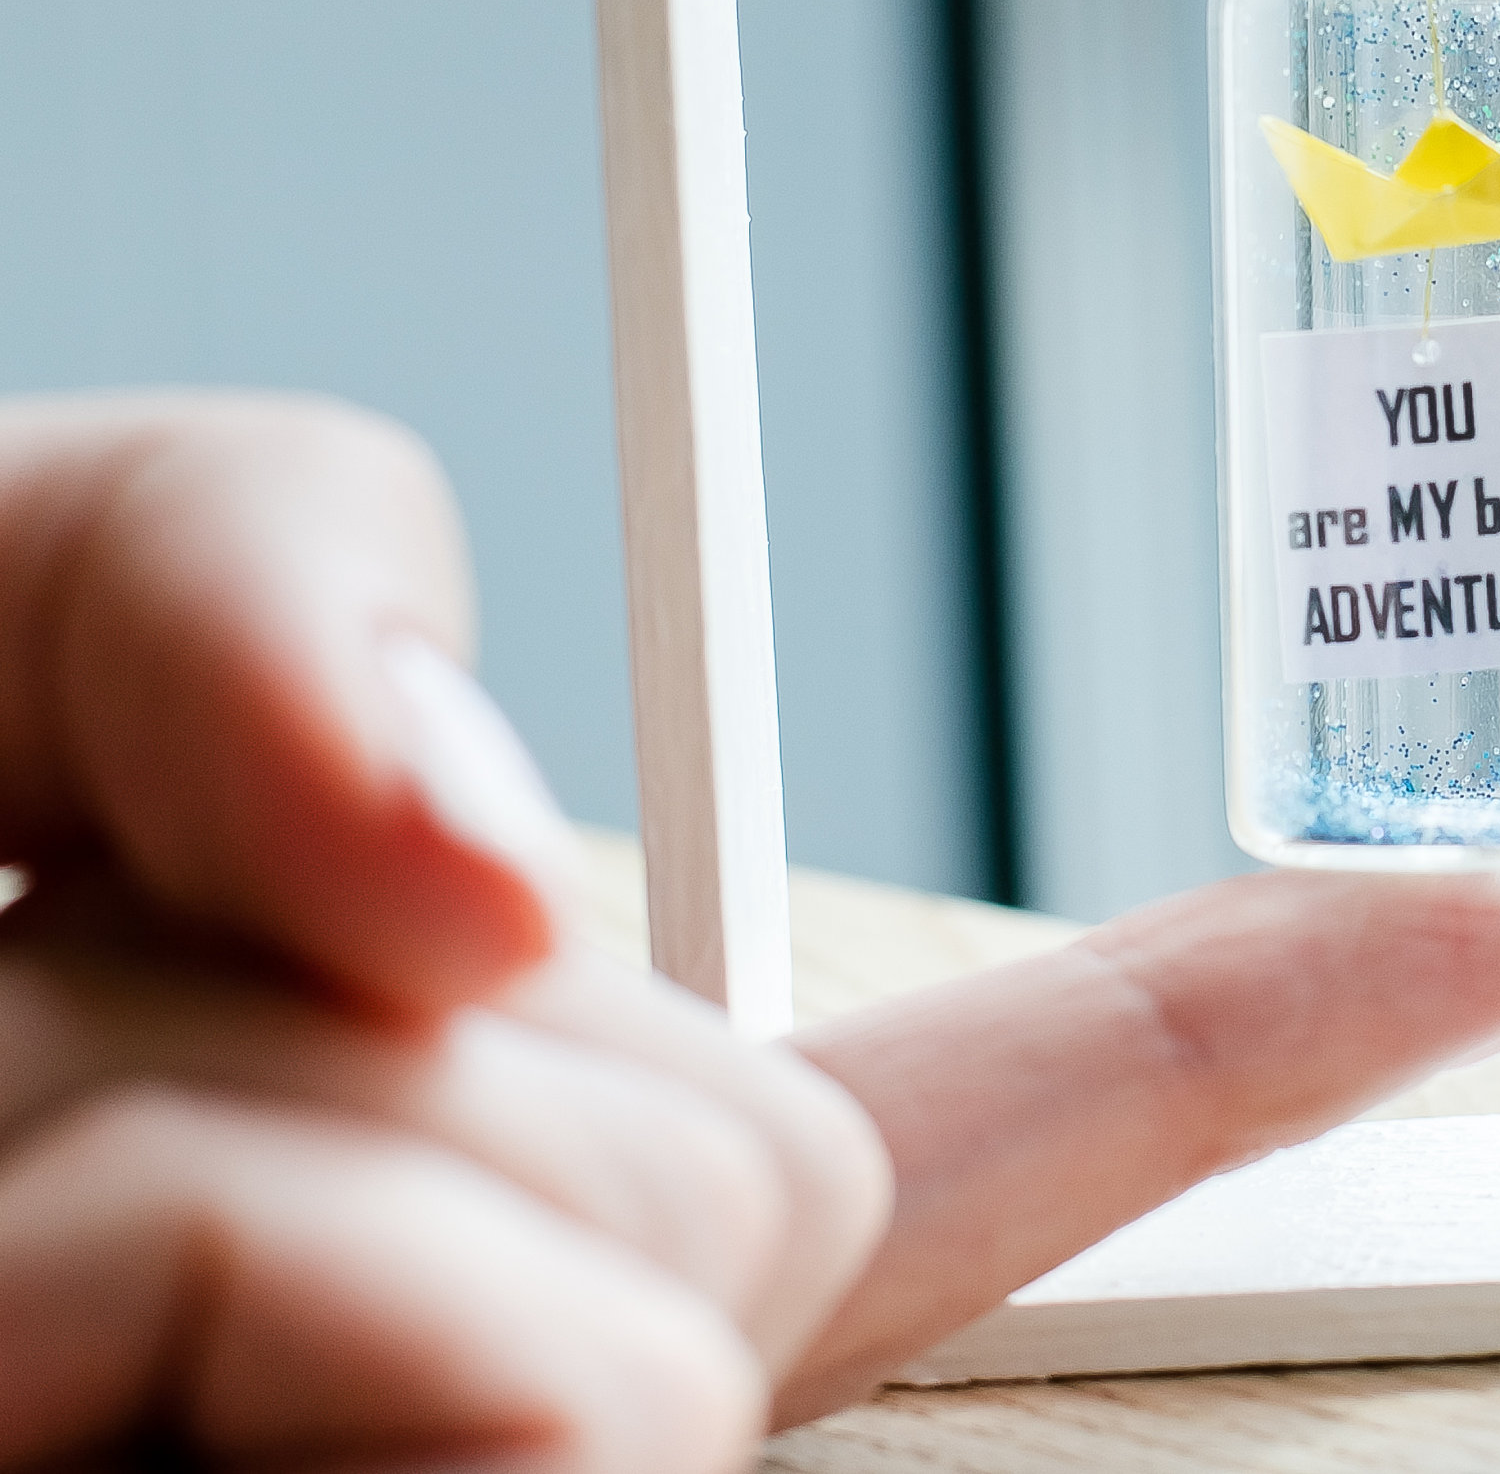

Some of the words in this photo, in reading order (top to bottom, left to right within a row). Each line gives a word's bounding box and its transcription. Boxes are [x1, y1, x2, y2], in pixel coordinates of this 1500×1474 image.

[1374, 381, 1476, 447] YOU
[1288, 507, 1370, 550] are
[1386, 479, 1459, 544] MY
